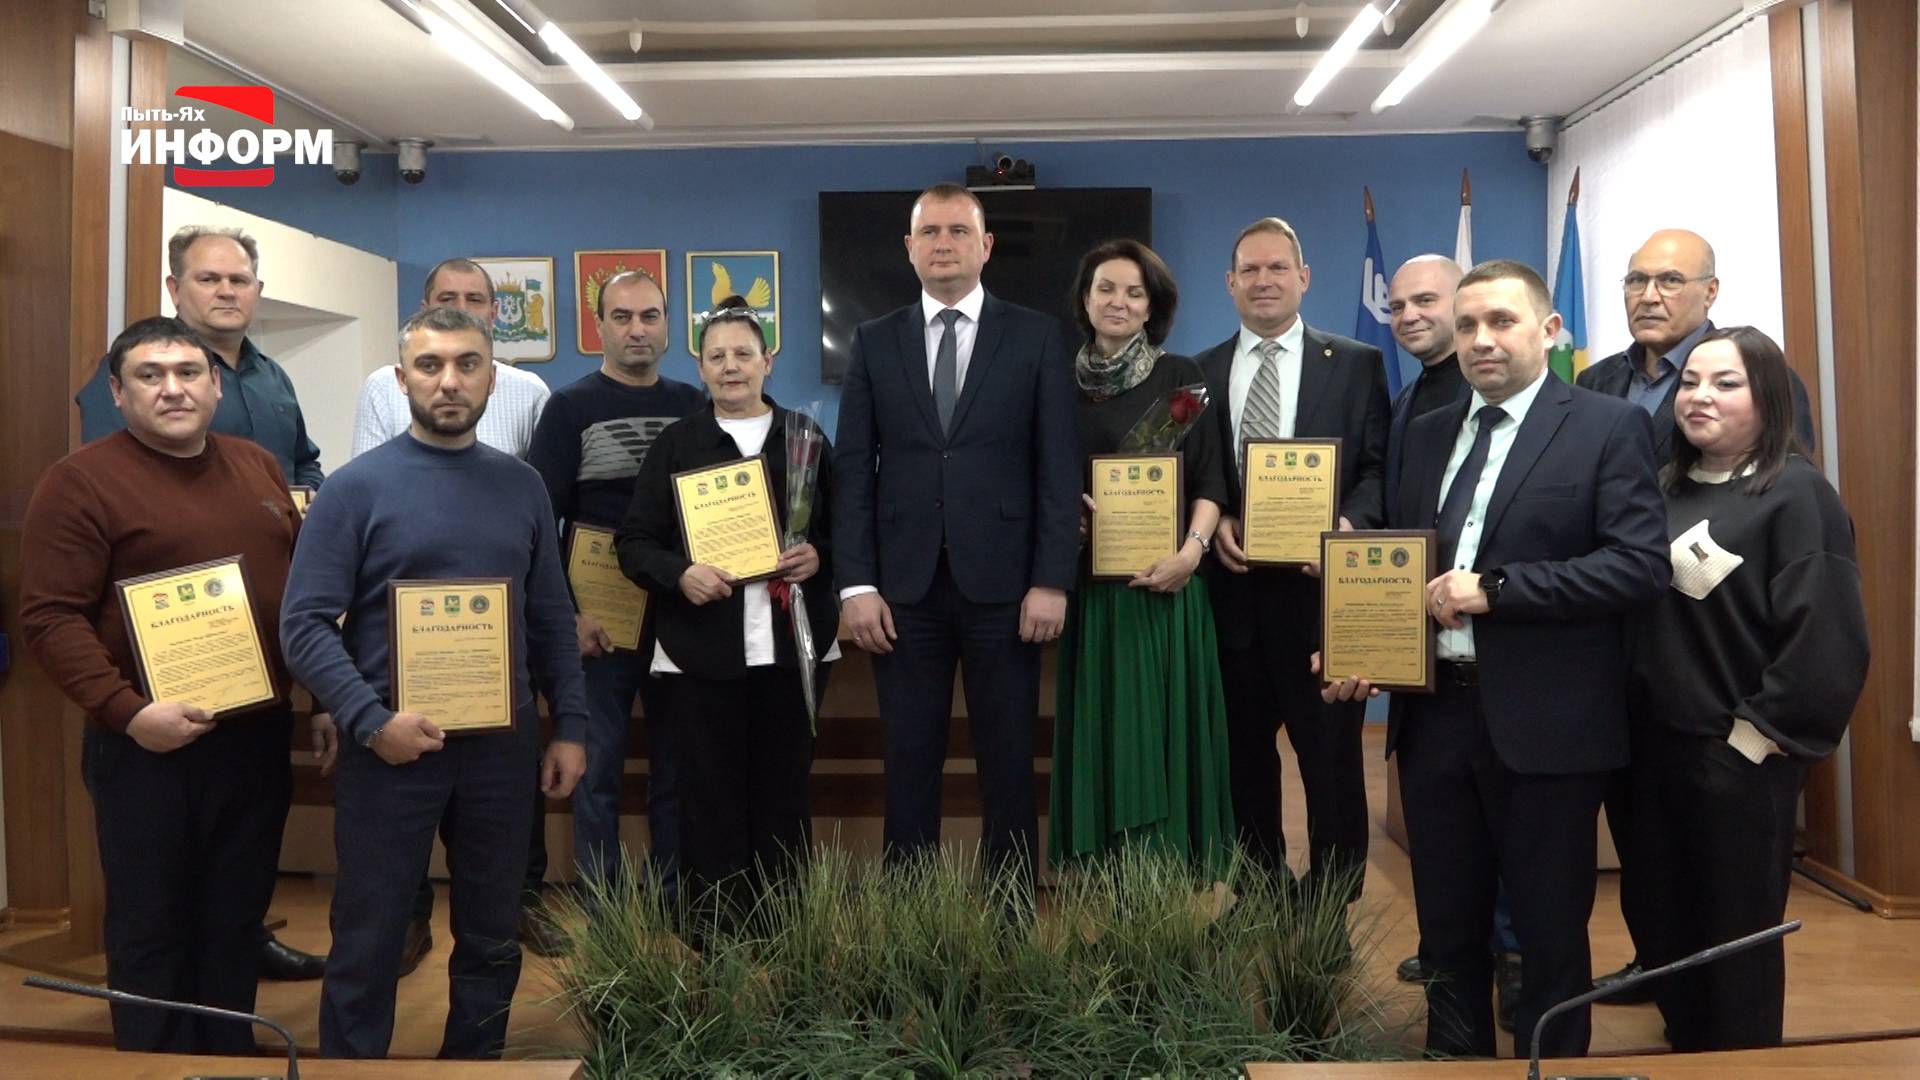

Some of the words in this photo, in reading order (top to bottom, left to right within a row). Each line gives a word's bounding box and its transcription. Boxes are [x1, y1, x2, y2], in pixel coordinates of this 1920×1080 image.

[1103, 488, 1166, 496] БЛАГОДАРНОСТЬ
[1338, 577, 1412, 585] БЛАГОДАРНОСТЬ
[151, 605, 235, 628] БЛАГОДАРНОСТЬ
[412, 623, 494, 633] БЛАГОДАРНОСТЬ
